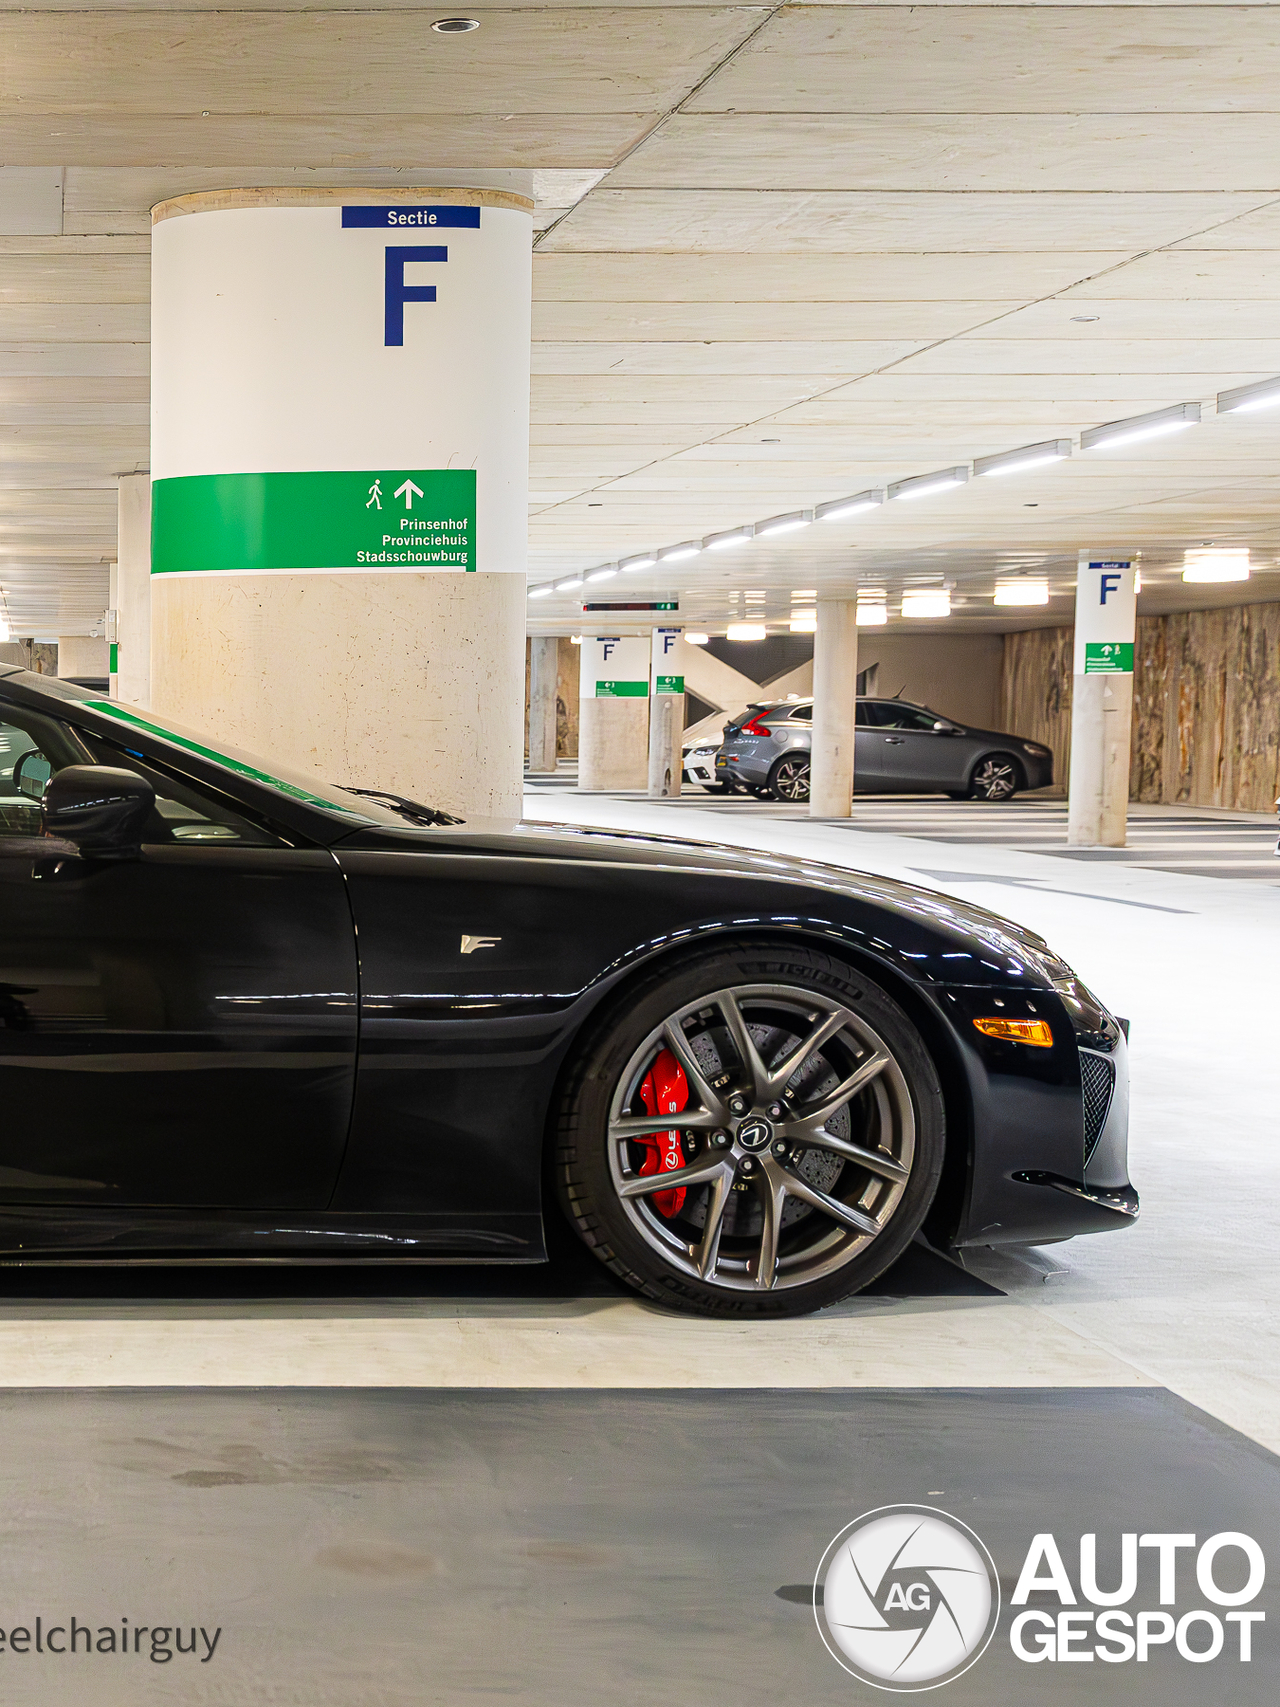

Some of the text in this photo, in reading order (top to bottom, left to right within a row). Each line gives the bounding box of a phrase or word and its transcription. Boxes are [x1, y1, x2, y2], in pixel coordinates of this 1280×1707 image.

[387, 210, 437, 225] Sectie
[384, 246, 448, 347] F
[400, 518, 468, 531] Prinsenhof
[382, 534, 468, 546] Provinciehuis
[356, 549, 468, 564] Stadsschouwburg
[1100, 574, 1122, 605] F
[603, 643, 615, 661] F
[663, 635, 676, 654] F
[668, 1101, 678, 1150] LES
